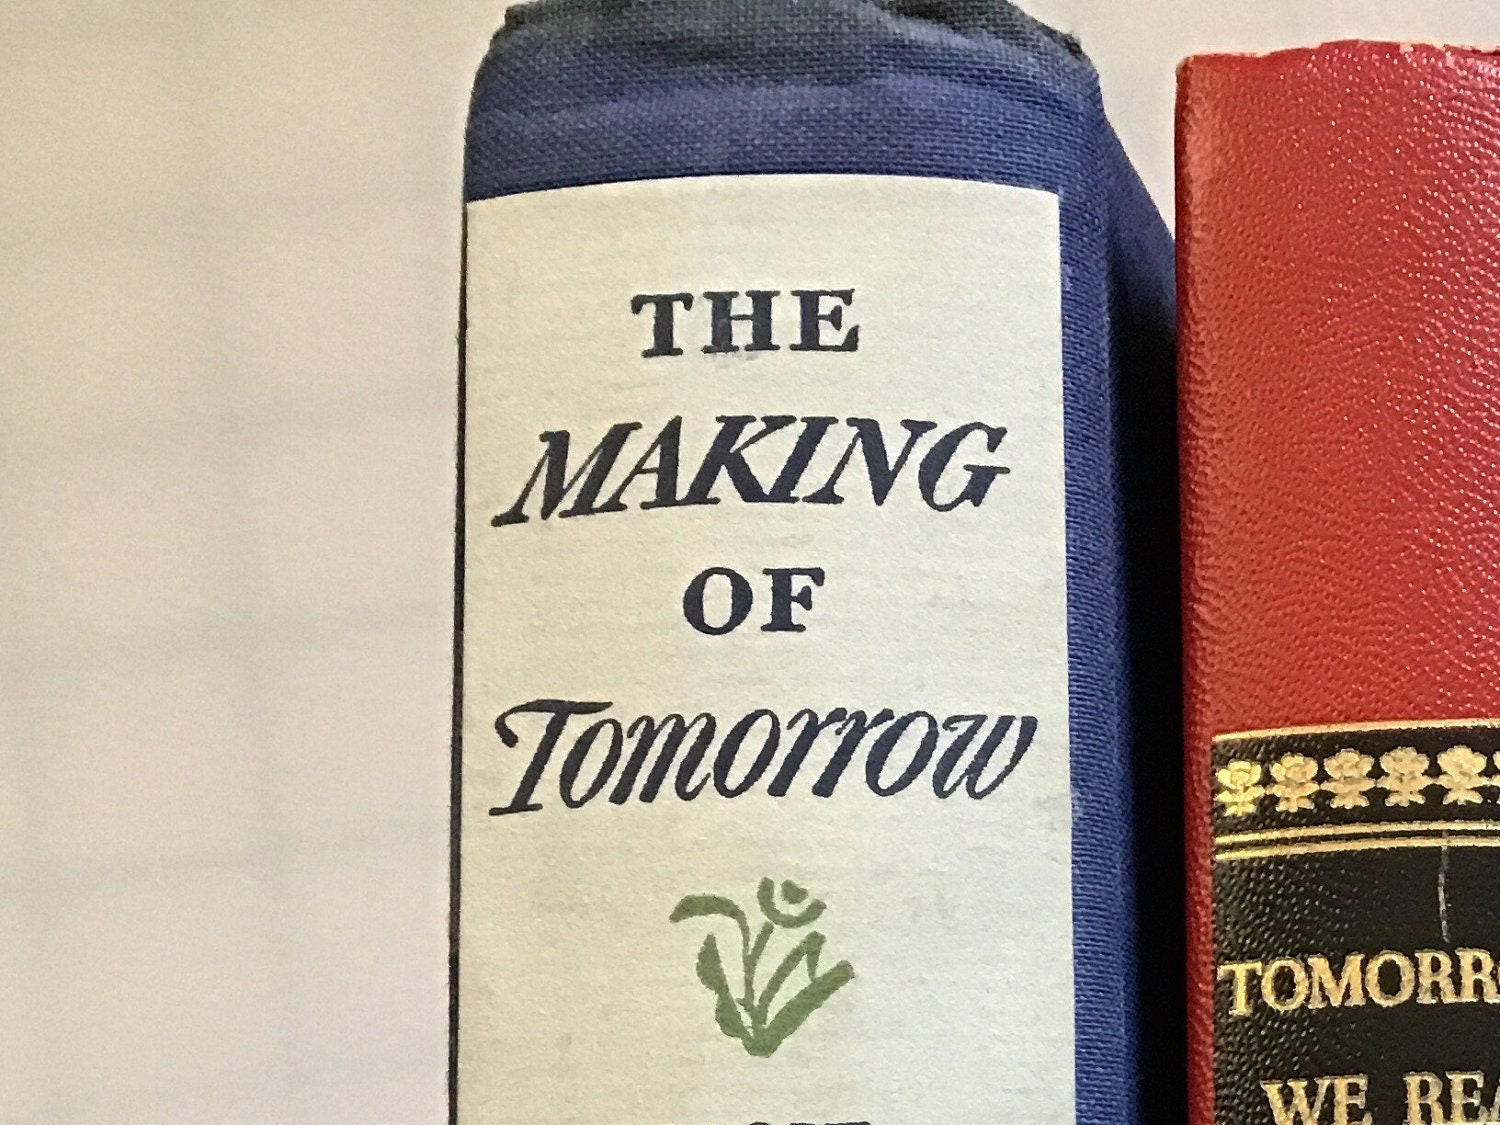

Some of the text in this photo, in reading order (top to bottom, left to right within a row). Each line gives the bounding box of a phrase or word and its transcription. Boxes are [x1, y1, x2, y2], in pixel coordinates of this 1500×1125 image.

[631, 289, 860, 357] THE
[490, 415, 1011, 527] MAKING
[682, 566, 826, 635] OF
[489, 699, 1038, 816] Tomorrow
